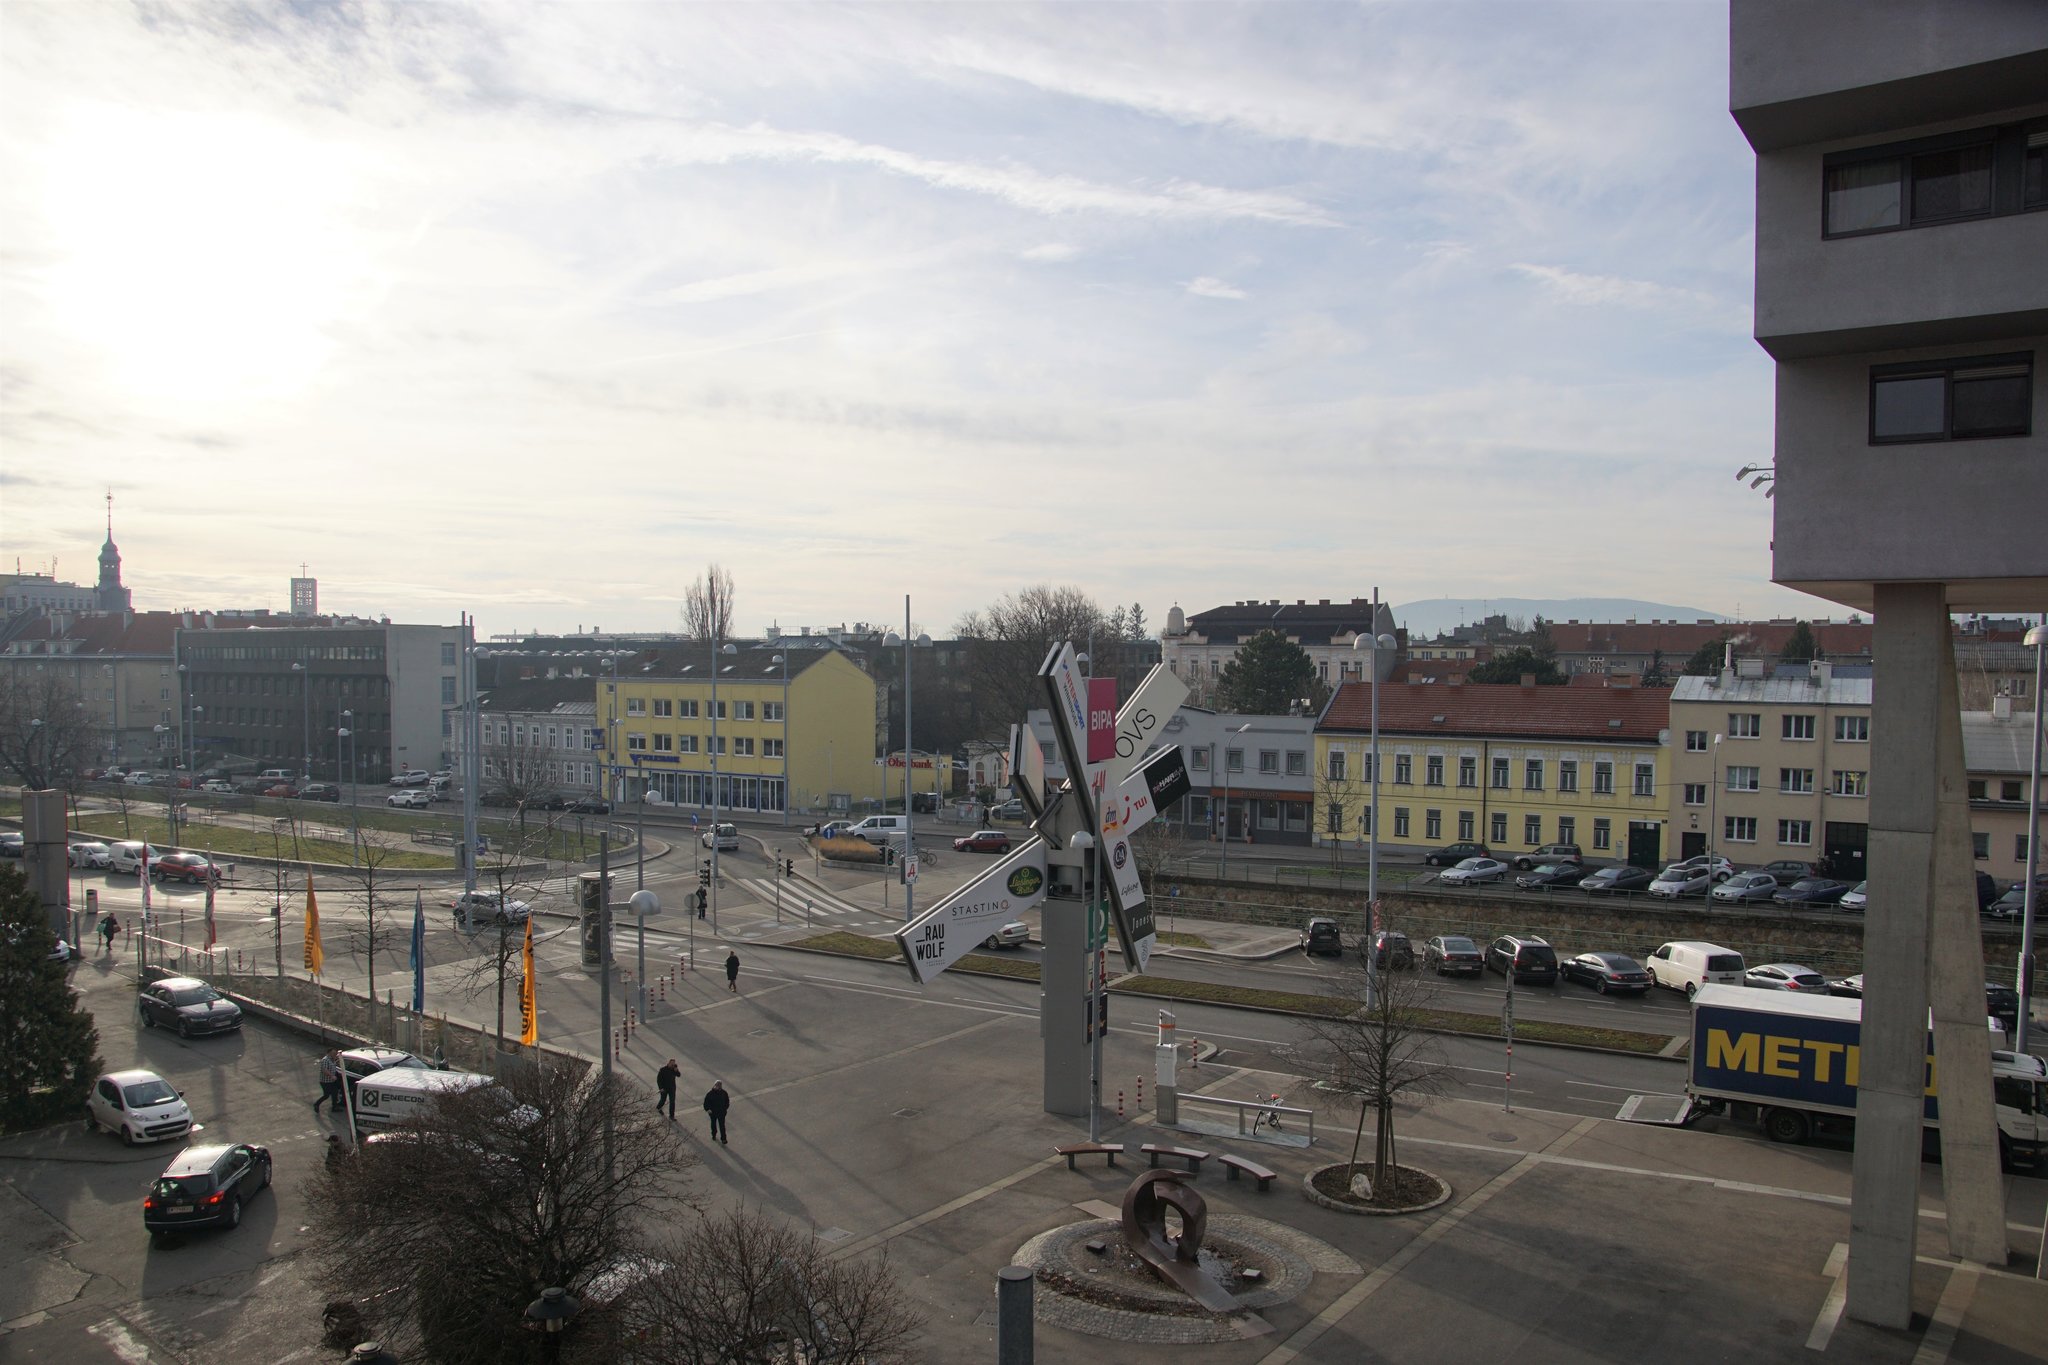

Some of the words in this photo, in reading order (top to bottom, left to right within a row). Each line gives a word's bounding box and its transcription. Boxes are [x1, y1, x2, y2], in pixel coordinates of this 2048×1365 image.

[1065, 670, 1085, 730] INTERSPORT
[1091, 709, 1113, 731] BIPA
[1115, 708, 1156, 758] OVS
[887, 757, 933, 769] Obebank
[1133, 796, 1148, 811] TUI
[1105, 806, 1117, 823] dm
[952, 900, 1009, 916] STASTINO
[916, 941, 945, 960] WOLF
[381, 1093, 424, 1103] ENECON
